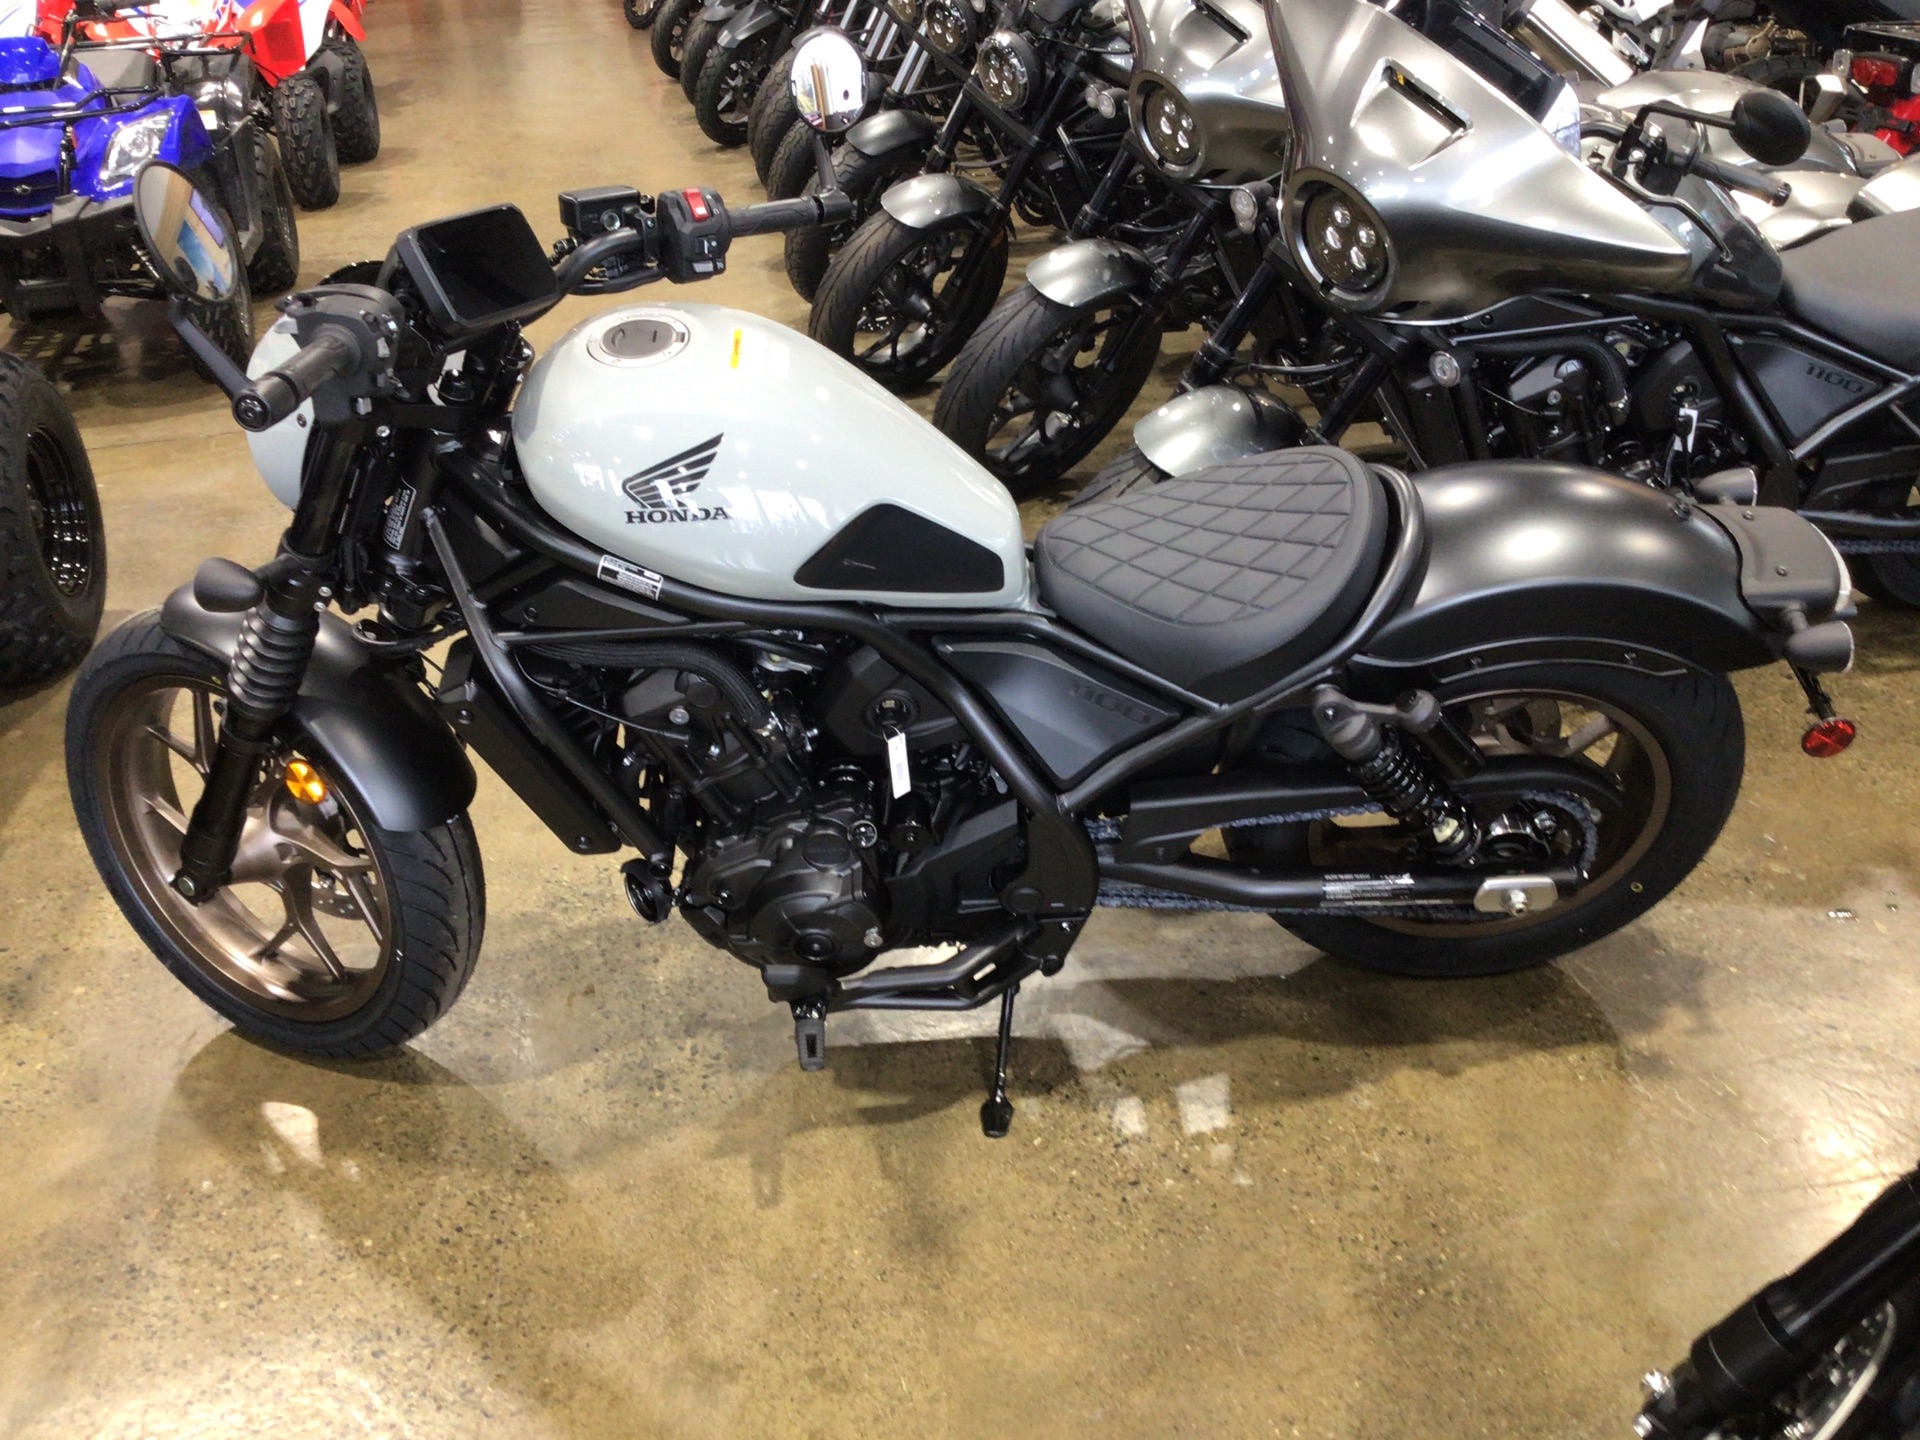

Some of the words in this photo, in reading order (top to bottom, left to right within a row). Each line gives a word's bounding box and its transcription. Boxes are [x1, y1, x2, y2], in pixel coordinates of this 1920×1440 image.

[1806, 362, 1863, 393] 1100
[624, 506, 733, 524] HONDA
[1068, 678, 1152, 724] 1100
